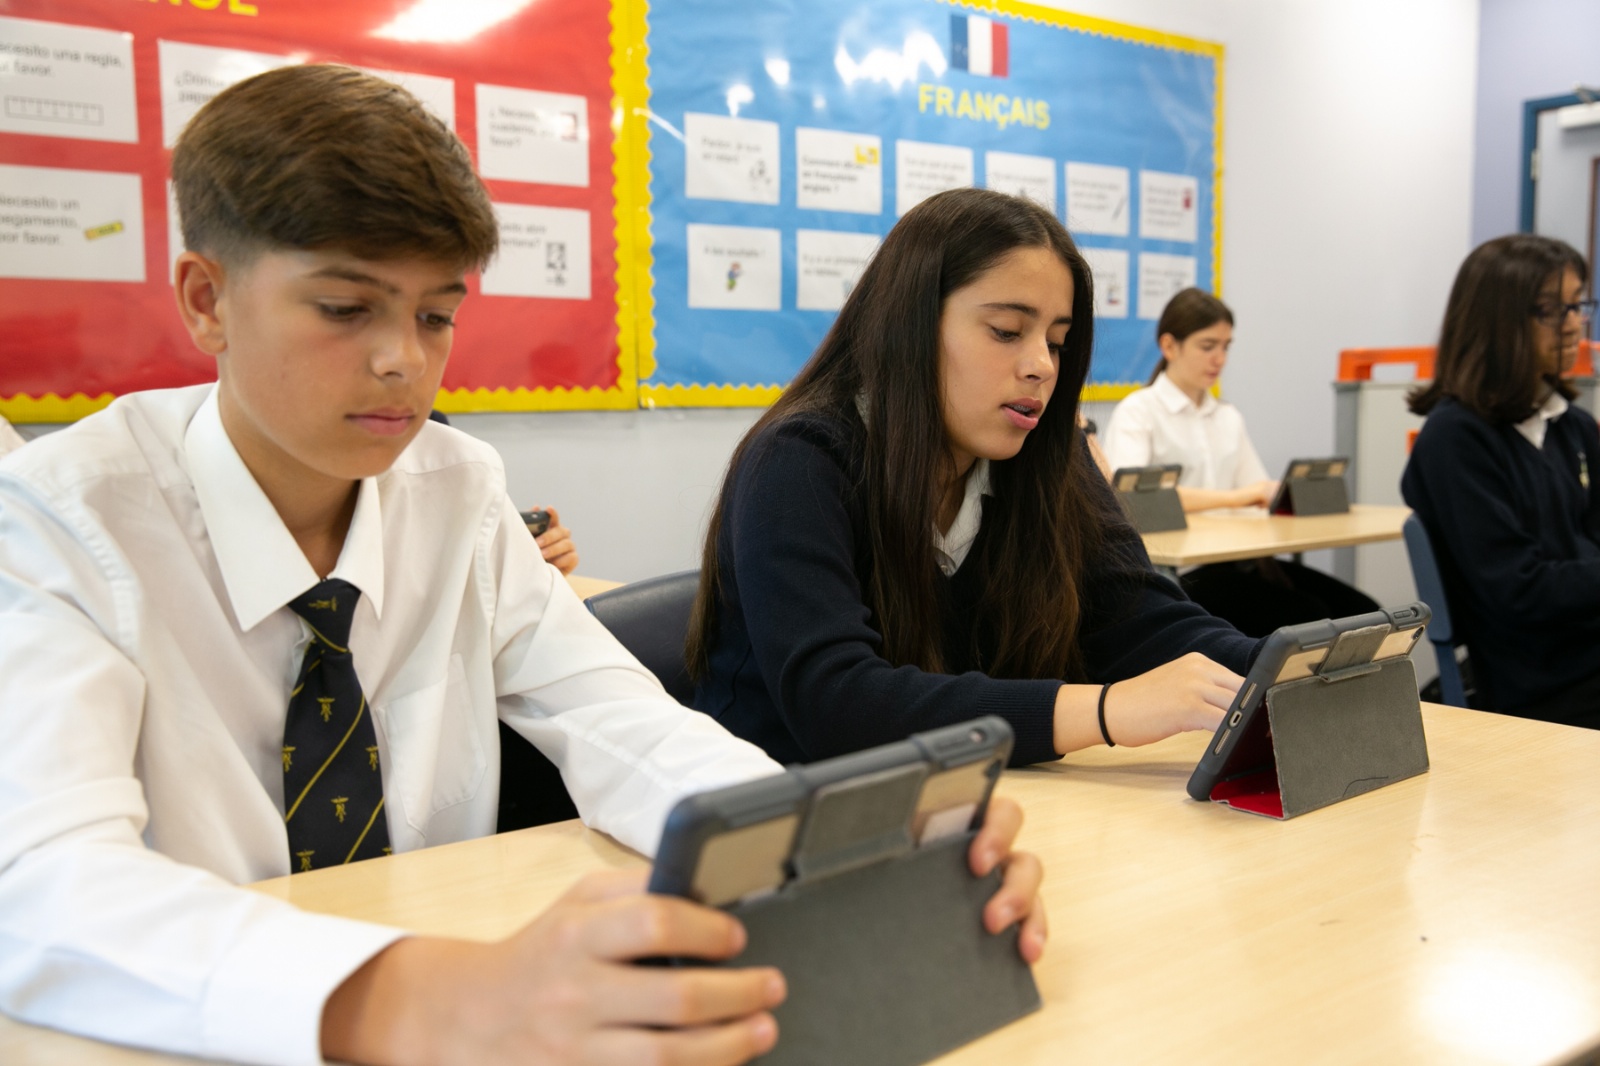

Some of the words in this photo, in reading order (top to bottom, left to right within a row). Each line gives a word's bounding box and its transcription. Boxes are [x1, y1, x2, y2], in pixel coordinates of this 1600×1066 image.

[52, 48, 81, 62] una
[918, 83, 1051, 131] FRANÇAIS
[60, 198, 80, 212] un
